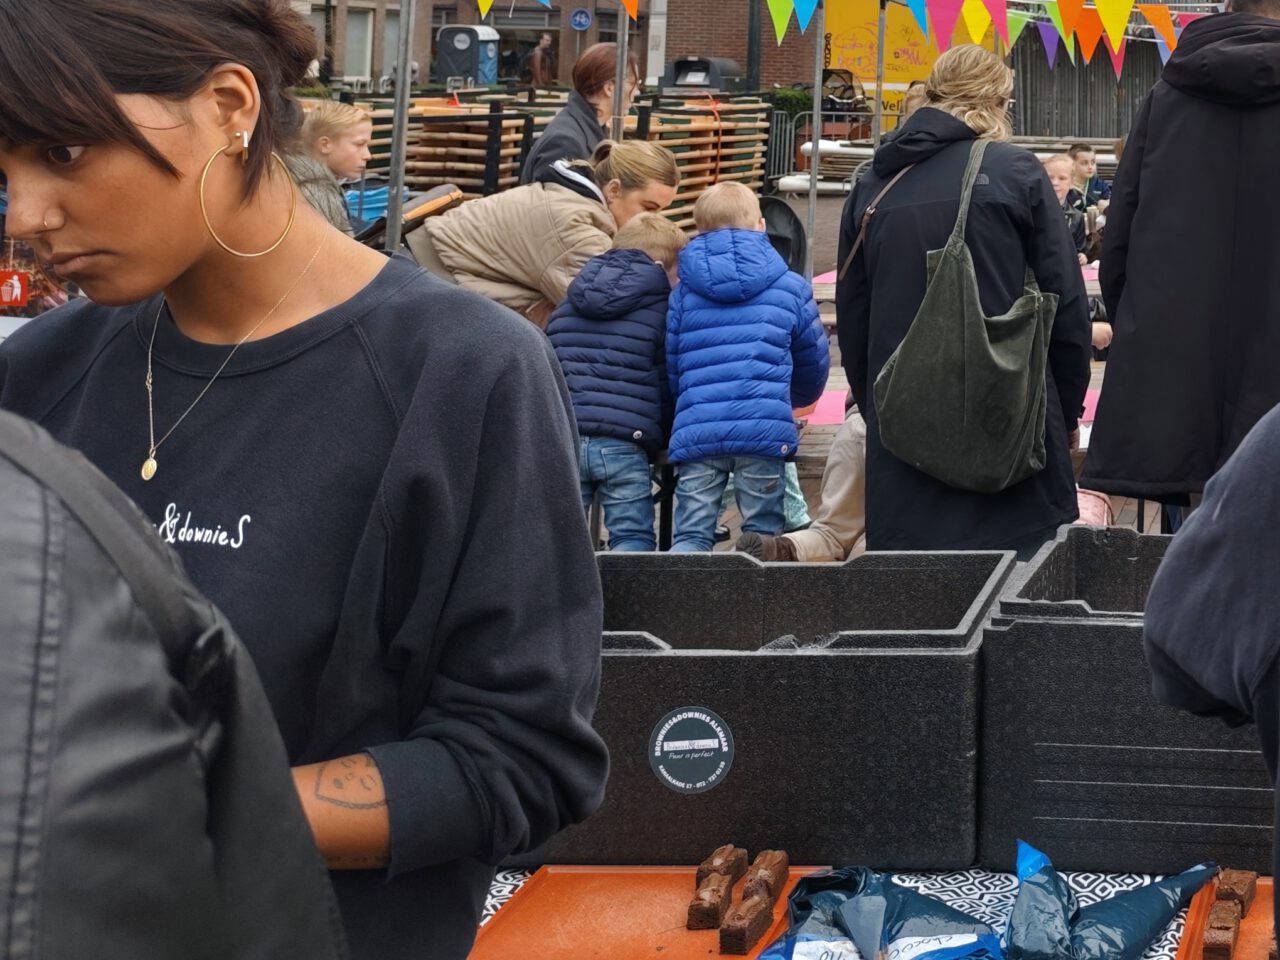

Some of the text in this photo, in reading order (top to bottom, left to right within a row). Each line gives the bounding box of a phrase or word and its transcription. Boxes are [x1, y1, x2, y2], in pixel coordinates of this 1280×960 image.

[153, 502, 251, 549] &downieS
[655, 712, 728, 756] BROWNIES&DOWNIES ALKMAAR
